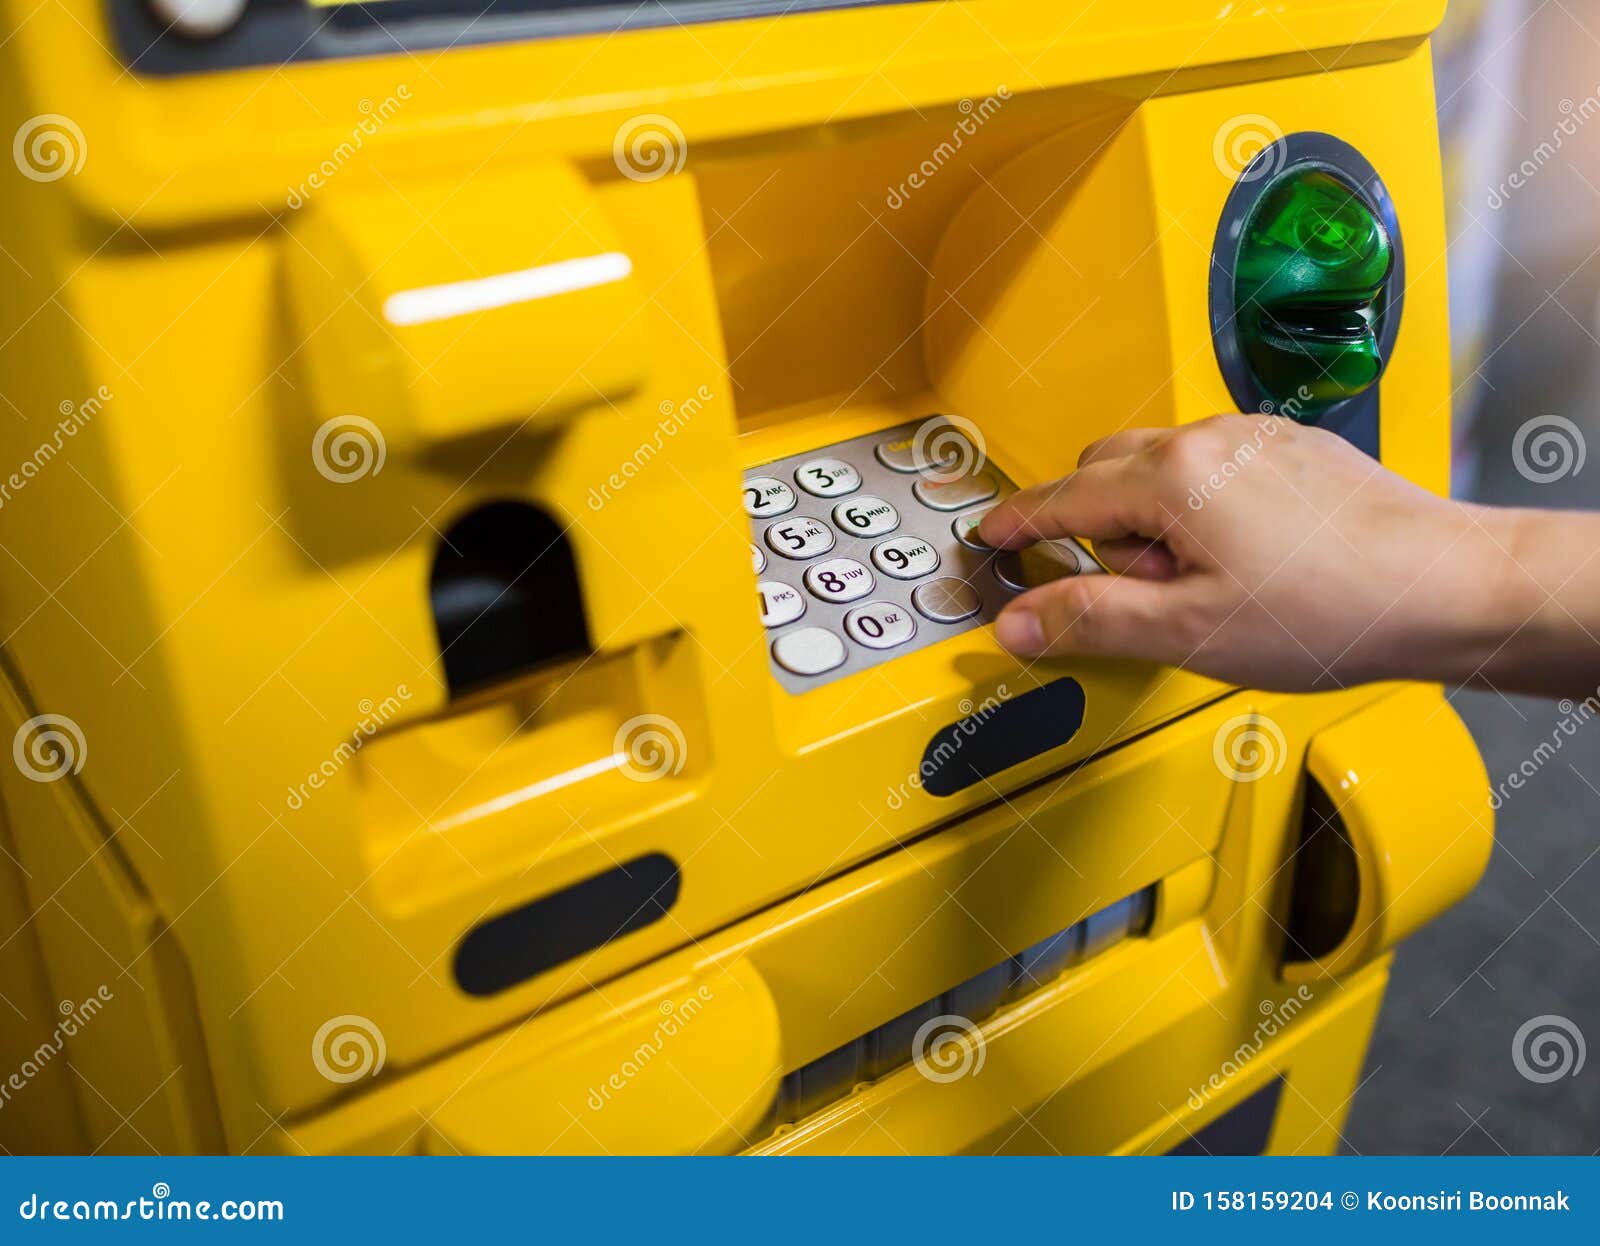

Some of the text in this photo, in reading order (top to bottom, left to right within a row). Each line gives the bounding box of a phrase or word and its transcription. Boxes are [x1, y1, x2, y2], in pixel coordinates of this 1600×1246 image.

[807, 467, 849, 488] 3 DEF
[743, 485, 787, 509] 2 ABC
[845, 506, 890, 528] 6 MNO
[778, 527, 823, 550] 5 JKL
[883, 545, 929, 570] 9 WXY
[817, 568, 864, 593] 8 TUV
[772, 590, 795, 602] PRS
[857, 615, 884, 638] 0
